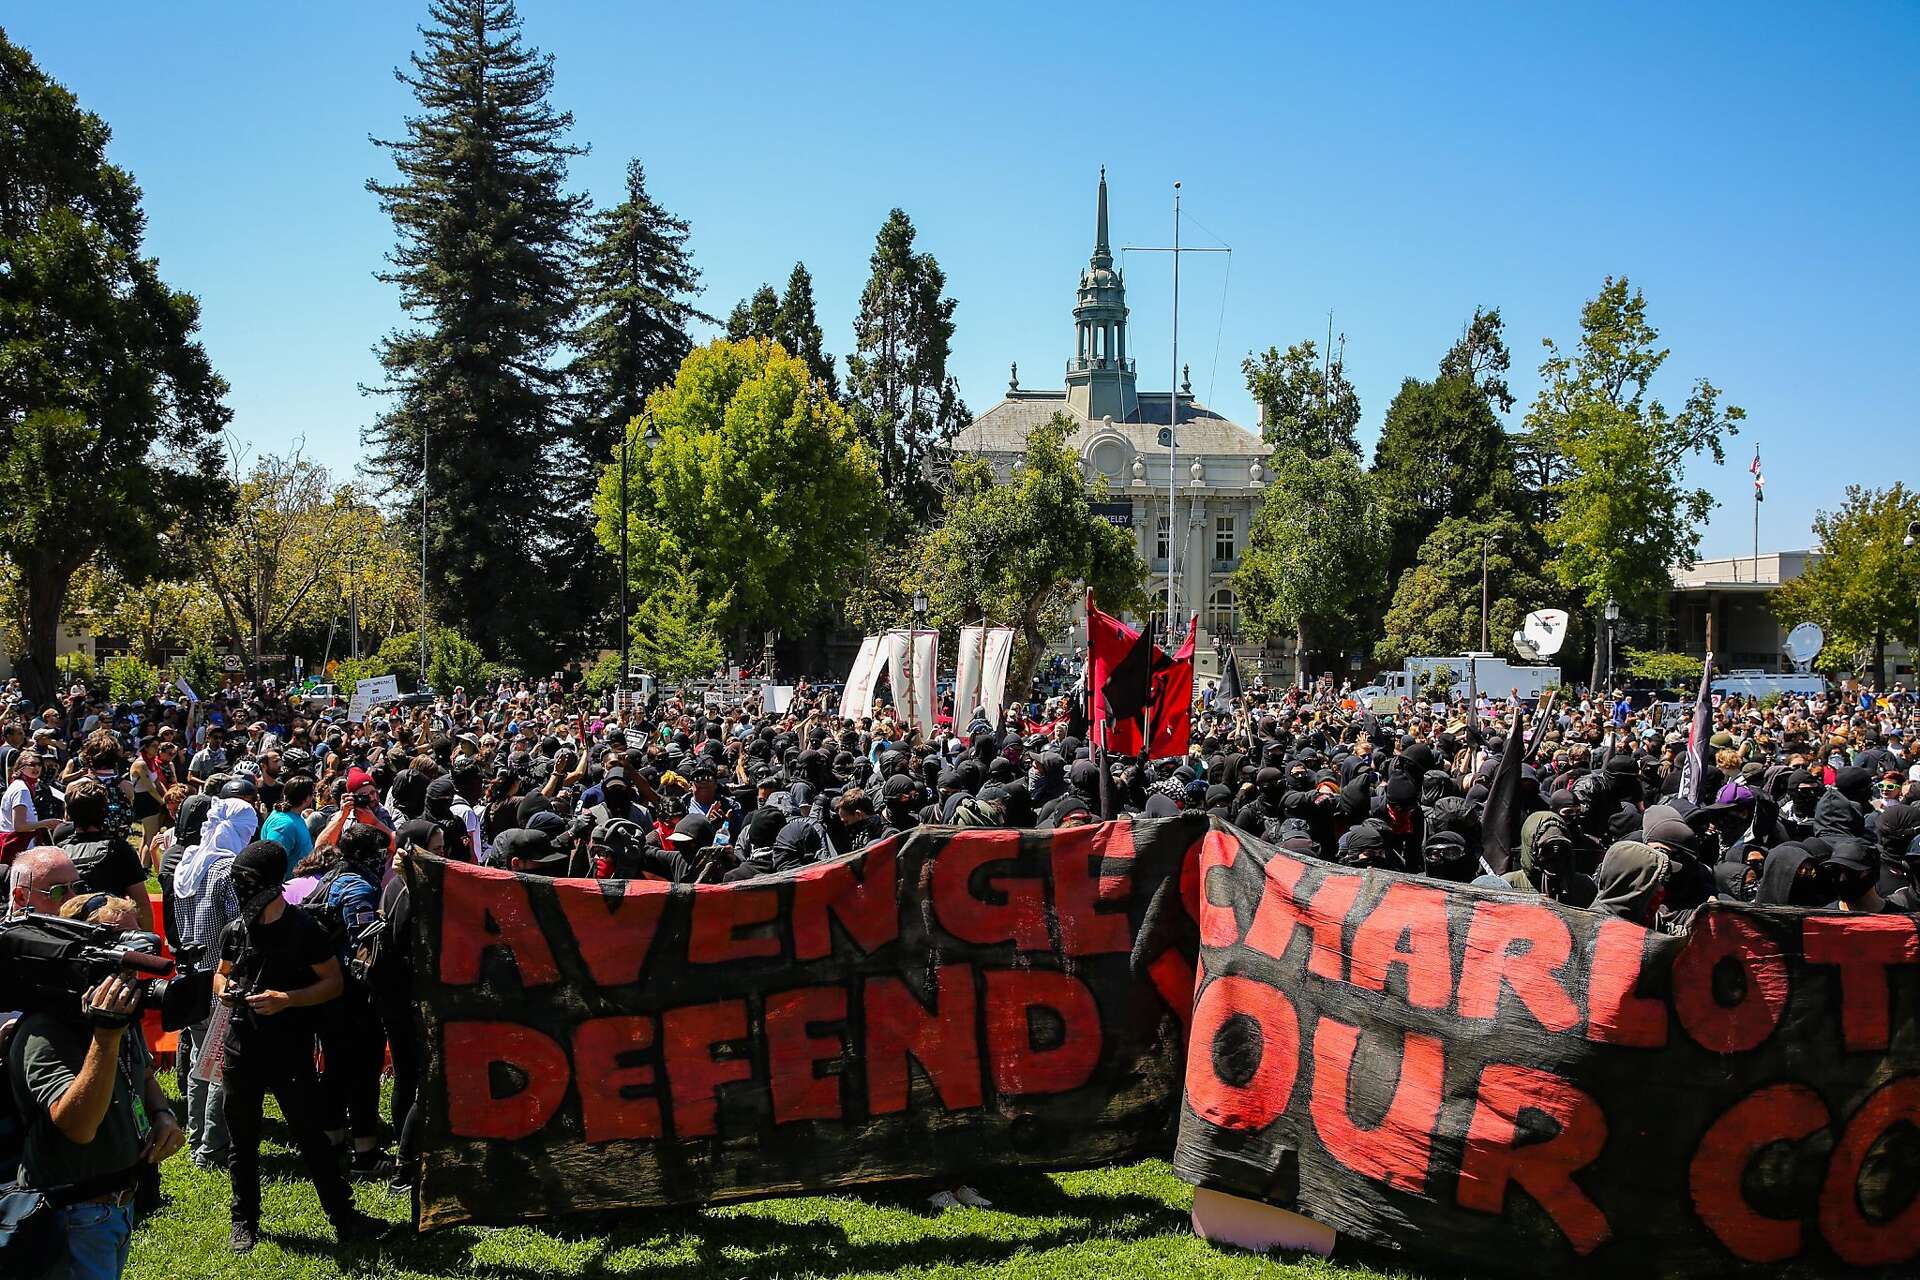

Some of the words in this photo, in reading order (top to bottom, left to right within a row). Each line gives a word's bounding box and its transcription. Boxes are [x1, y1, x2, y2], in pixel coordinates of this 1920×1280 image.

[440, 822, 1133, 987] AVENGE
[1180, 829, 1918, 1052] CHARLOT
[443, 964, 1103, 1143] DEFEND
[1185, 975, 1615, 1257] OUR
[1690, 1077, 1920, 1267] CO
